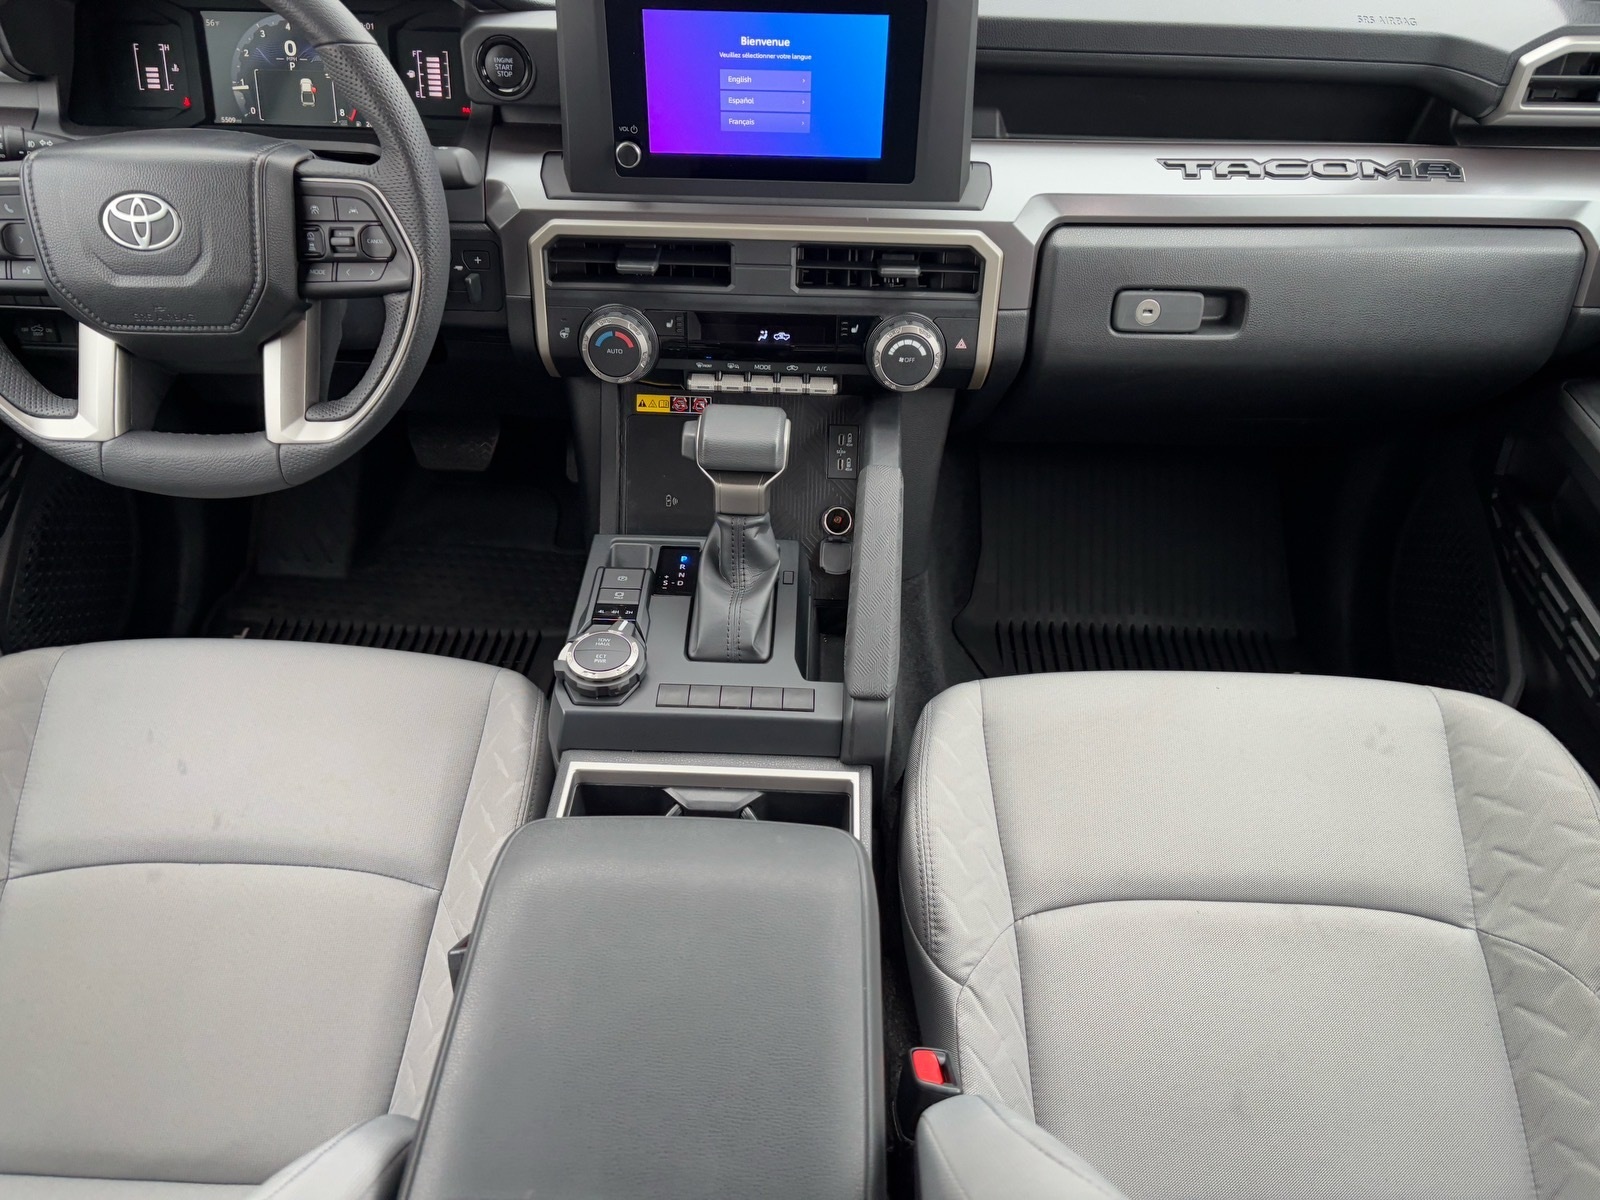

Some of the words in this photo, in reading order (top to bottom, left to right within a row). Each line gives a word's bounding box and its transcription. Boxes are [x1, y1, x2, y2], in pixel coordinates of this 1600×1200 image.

[1357, 14, 1375, 24] SRS
[1379, 15, 1417, 26] AIRBAG
[285, 22, 291, 31] 4
[260, 29, 266, 38] 3
[740, 36, 791, 47] Bienvenue
[243, 48, 250, 57] 2
[284, 39, 297, 57] 0
[719, 51, 741, 59] Veuillez
[741, 52, 776, 60] sélectionner
[791, 53, 812, 61] langue
[289, 61, 296, 71] P
[495, 63, 513, 71] START
[496, 70, 513, 78] STOP
[727, 75, 752, 85] English
[728, 96, 755, 105] Español
[250, 106, 256, 115] 0
[339, 108, 345, 117] 8
[728, 117, 755, 126] Français
[1155, 158, 1466, 182] TACOMA
[309, 268, 326, 276] MODE
[904, 356, 916, 364] OFF
[753, 363, 773, 371] MODE
[816, 365, 828, 373] A/C
[680, 555, 688, 563] P
[679, 563, 687, 571] R
